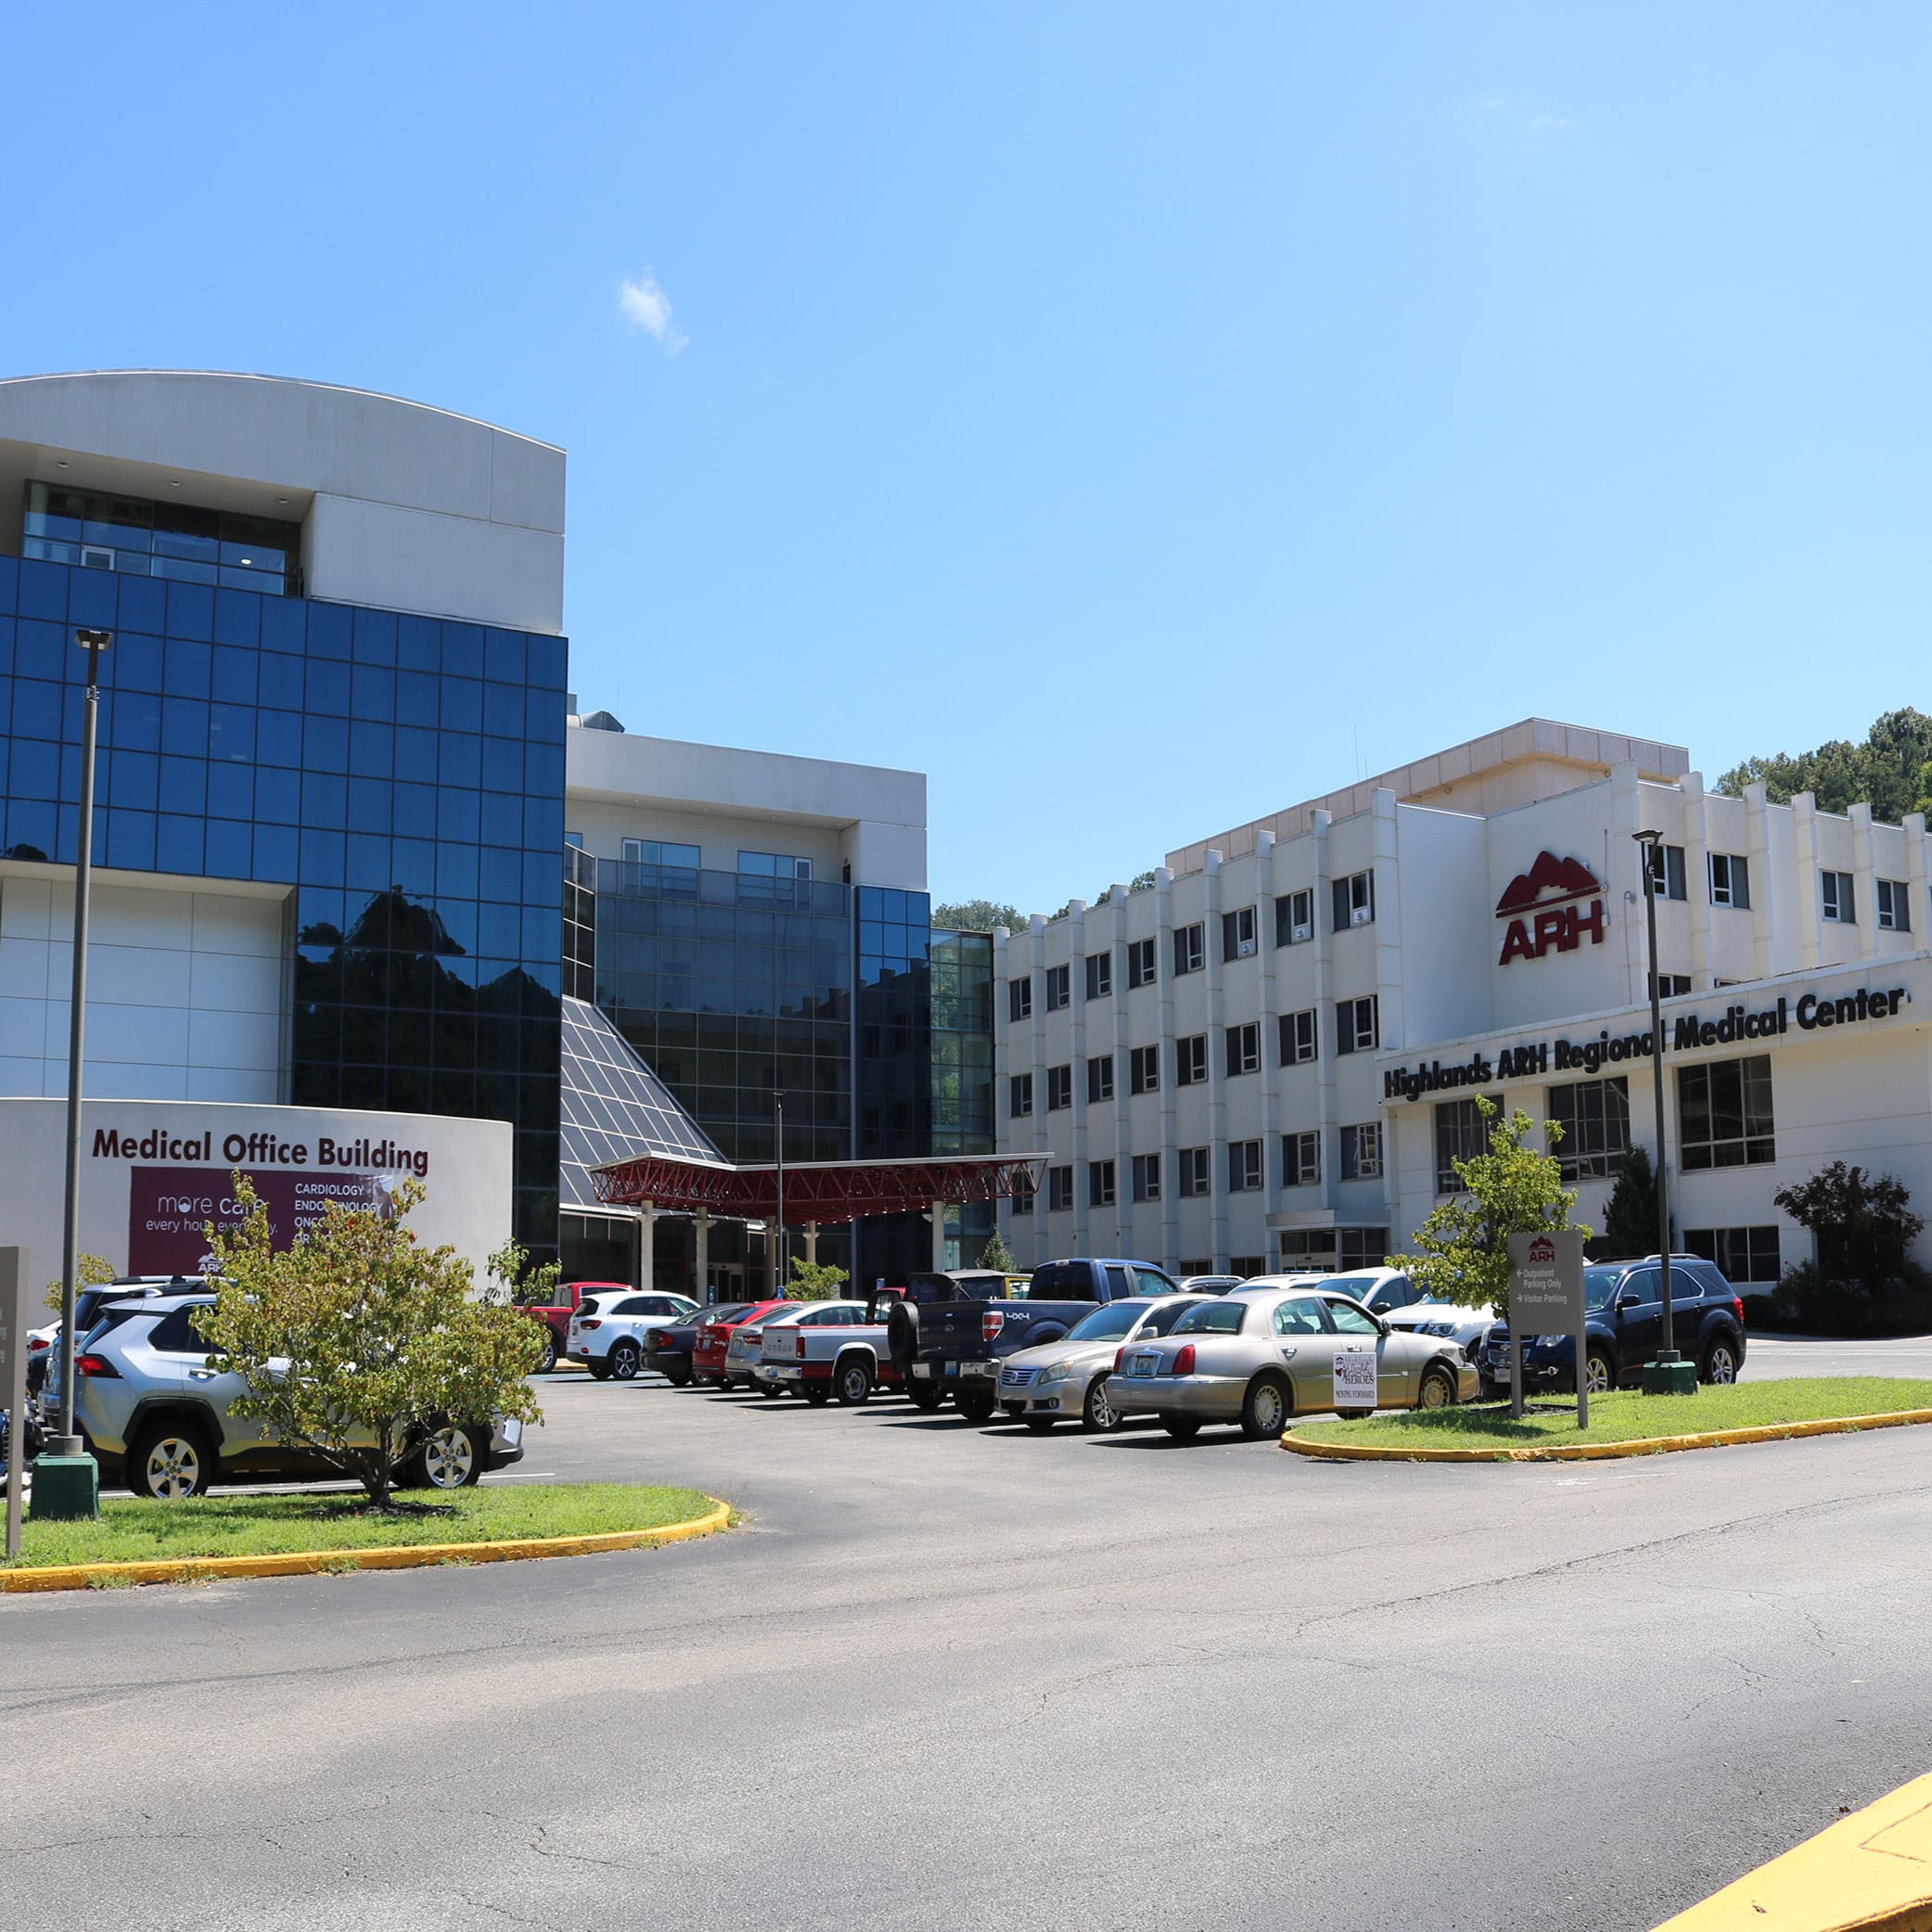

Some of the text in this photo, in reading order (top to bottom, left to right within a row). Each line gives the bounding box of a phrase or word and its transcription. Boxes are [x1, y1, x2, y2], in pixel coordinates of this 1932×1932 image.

[1499, 900, 1603, 966] ARH
[1384, 988, 1905, 1101] Highlands ARH Regional Medical Center
[92, 1129, 429, 1177] Medical Office Building
[295, 1183, 365, 1196] CARDIOLOGY
[158, 1196, 212, 1213] more
[146, 1220, 180, 1234] every
[184, 1218, 210, 1232] hou
[1529, 1250, 1555, 1262] ARH
[1523, 1278, 1562, 1290] Parking Only
[1543, 1293, 1567, 1305] Parking
